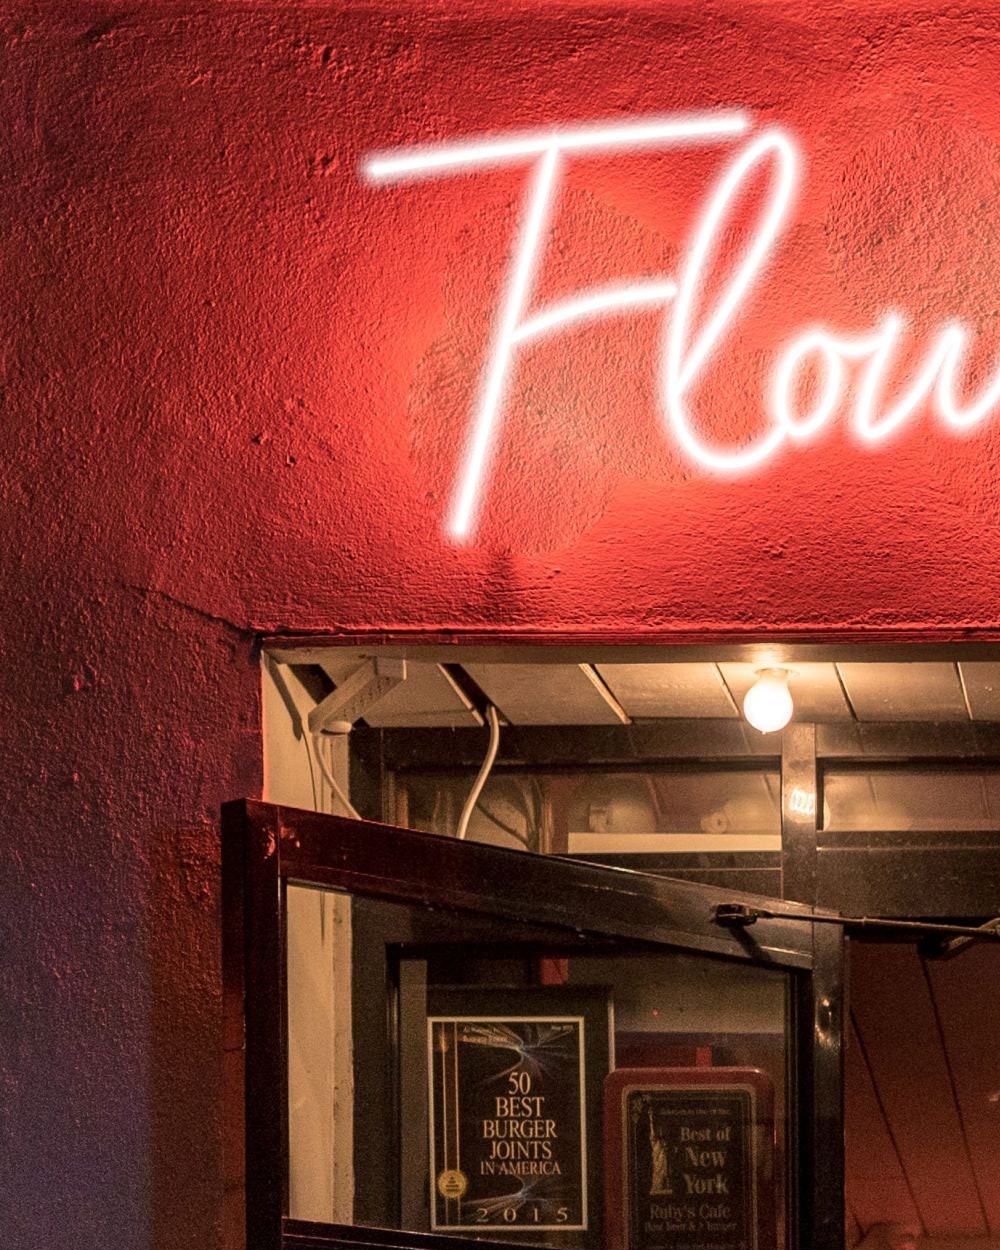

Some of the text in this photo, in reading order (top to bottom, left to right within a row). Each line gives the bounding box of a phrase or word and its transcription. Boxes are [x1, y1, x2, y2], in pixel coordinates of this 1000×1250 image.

[508, 1071, 531, 1095] 50
[496, 1096, 545, 1118] BEST
[482, 1119, 557, 1139] BURGER
[681, 1126, 731, 1141] Best of
[489, 1140, 552, 1160] JOINTS
[685, 1146, 728, 1168] New
[480, 1161, 562, 1175] IN AMERICA
[683, 1173, 729, 1194] York
[476, 1207, 568, 1223] 2015
[650, 1203, 696, 1221] Ruby's
